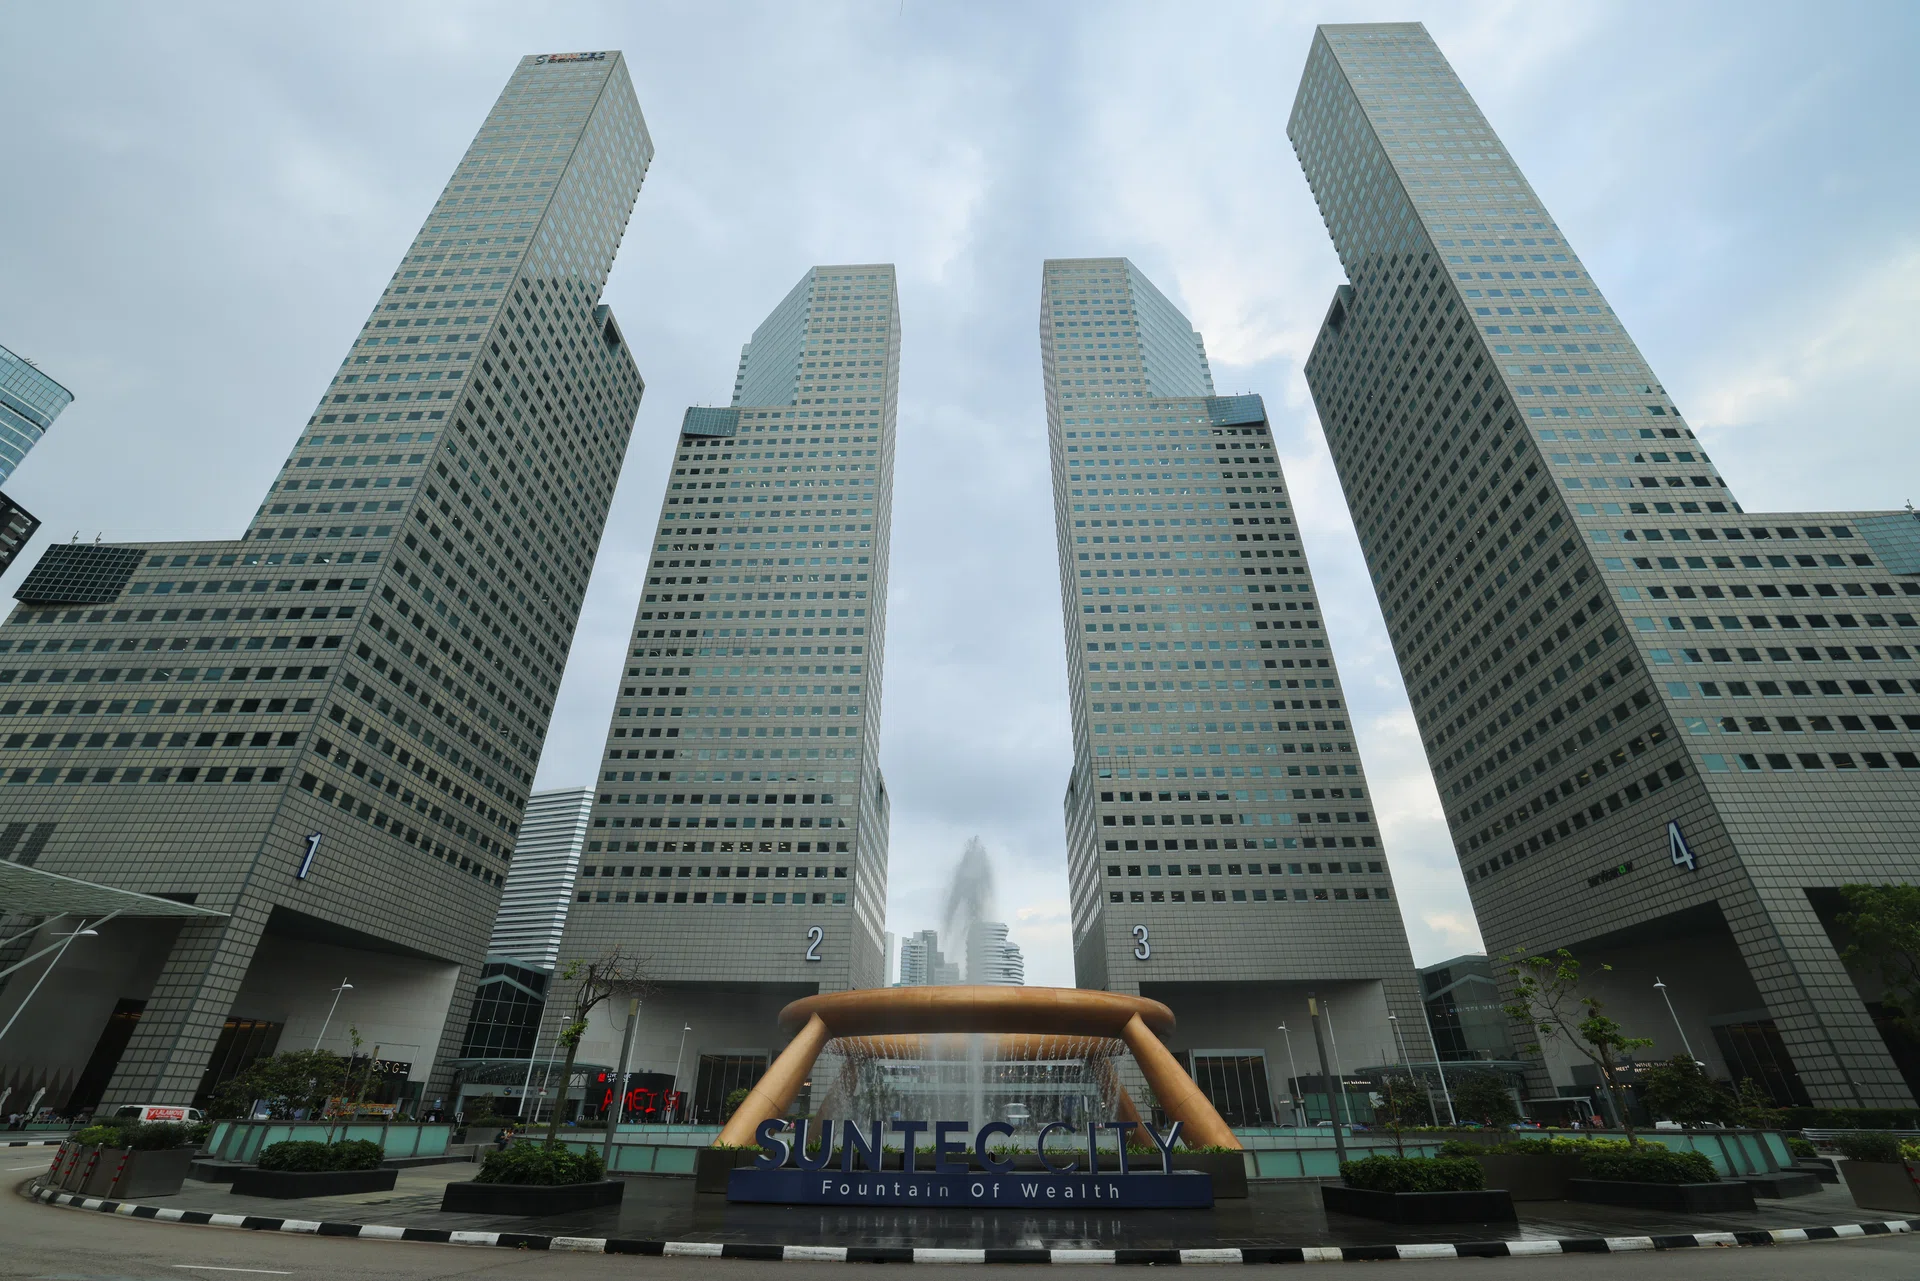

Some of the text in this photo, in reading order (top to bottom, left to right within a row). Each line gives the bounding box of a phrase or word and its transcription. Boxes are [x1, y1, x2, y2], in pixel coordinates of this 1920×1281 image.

[296, 832, 322, 879] 1
[1667, 819, 1697, 872] 4
[806, 925, 824, 961] 2
[1132, 924, 1151, 961] 3
[753, 1118, 1184, 1175] SUNTEC CITY
[822, 1180, 1119, 1198] Fountain Of Wealth
